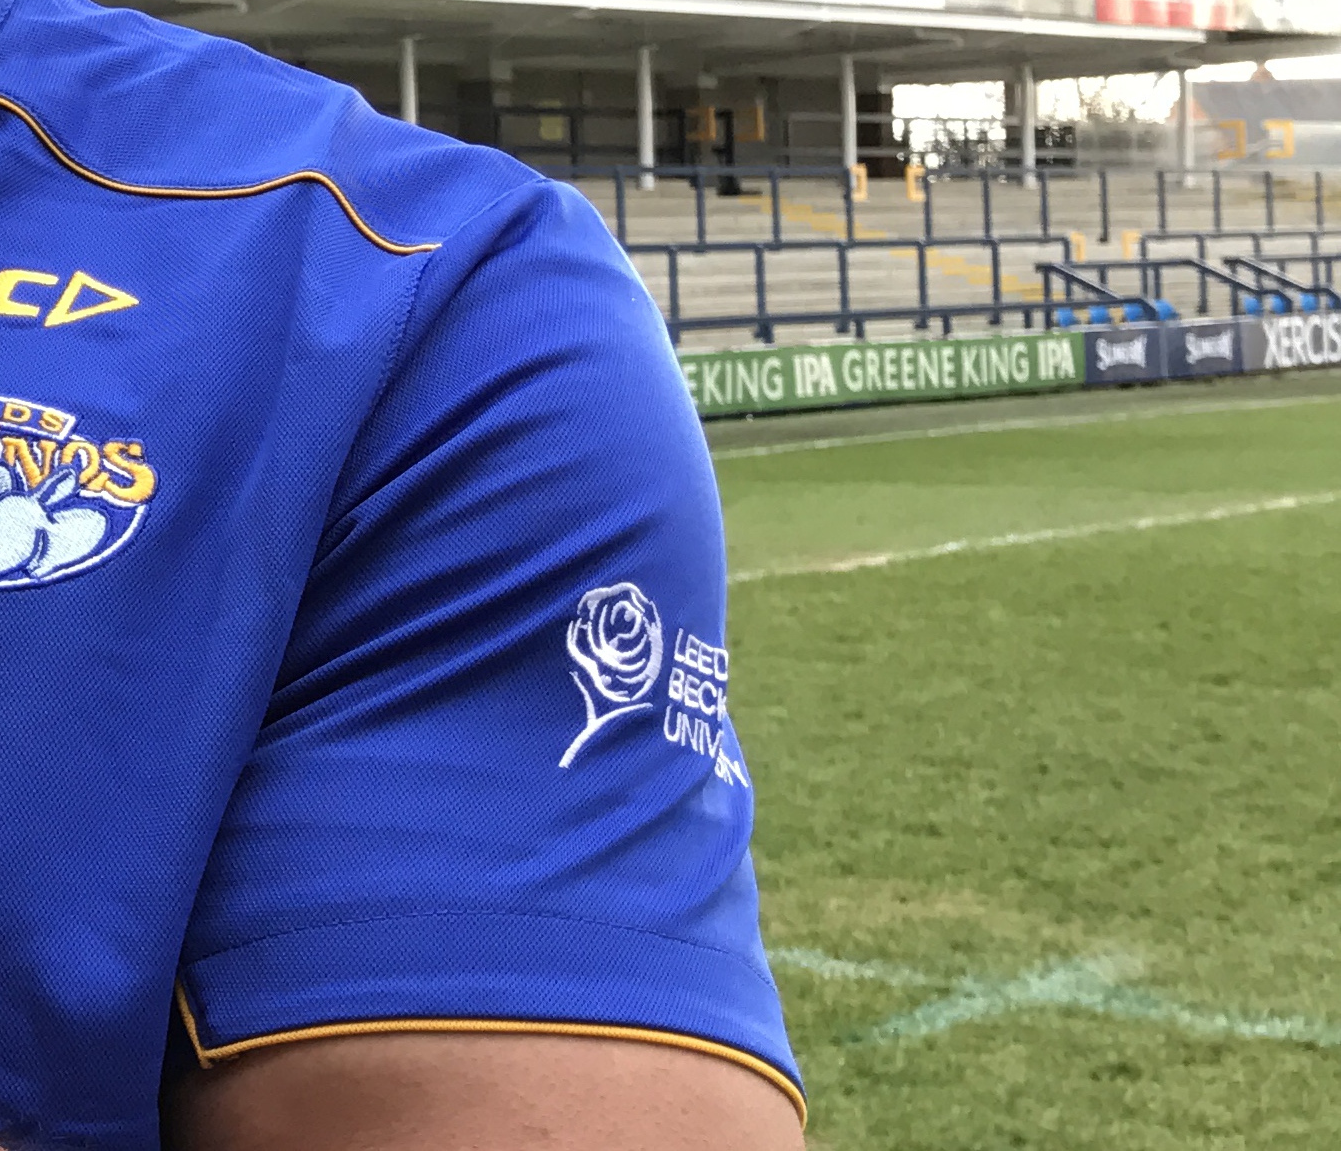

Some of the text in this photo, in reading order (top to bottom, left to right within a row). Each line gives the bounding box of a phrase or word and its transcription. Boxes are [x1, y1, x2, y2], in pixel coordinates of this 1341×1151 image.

[702, 355, 785, 407] KING
[793, 351, 838, 399] IPA
[841, 346, 957, 394] GREENE
[961, 340, 1030, 387] KING
[1037, 333, 1076, 381] IPA
